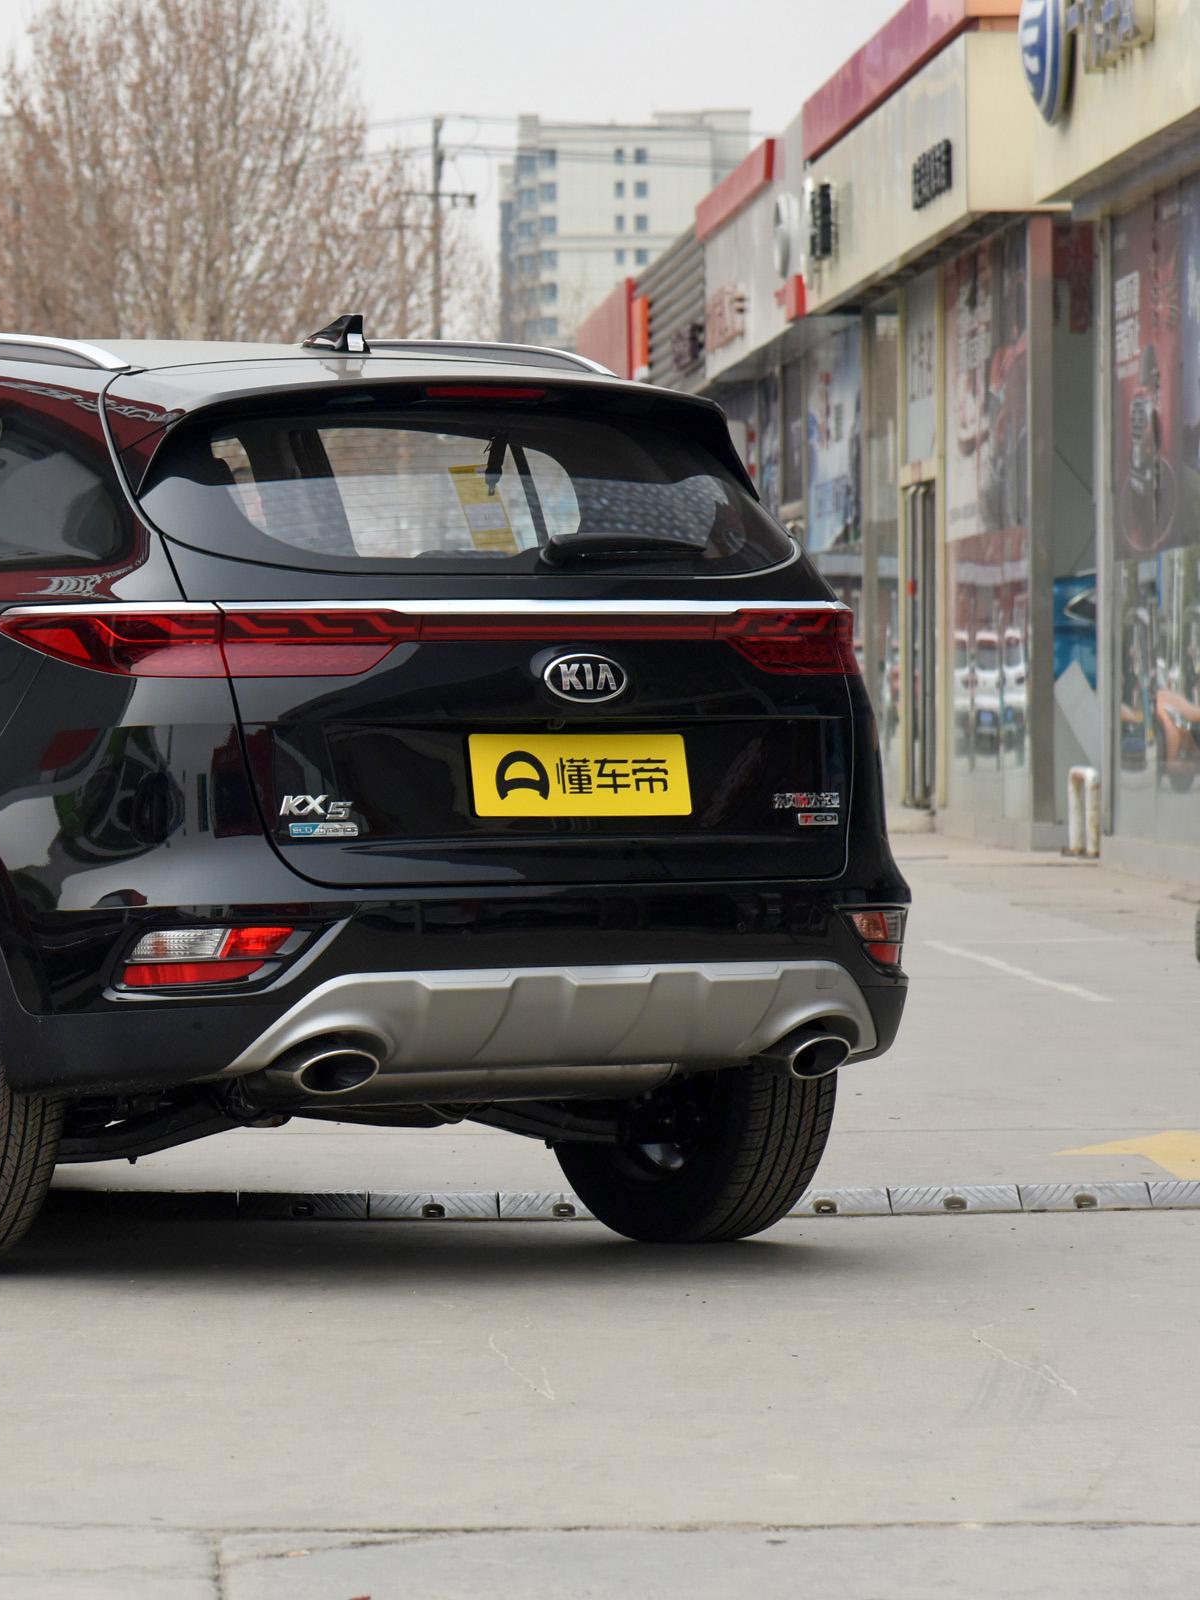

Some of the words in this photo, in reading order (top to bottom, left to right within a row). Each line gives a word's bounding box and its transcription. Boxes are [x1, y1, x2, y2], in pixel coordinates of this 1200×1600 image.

[558, 662, 618, 691] KIA
[555, 757, 669, 795] 懂车帝
[279, 794, 353, 820] KX5
